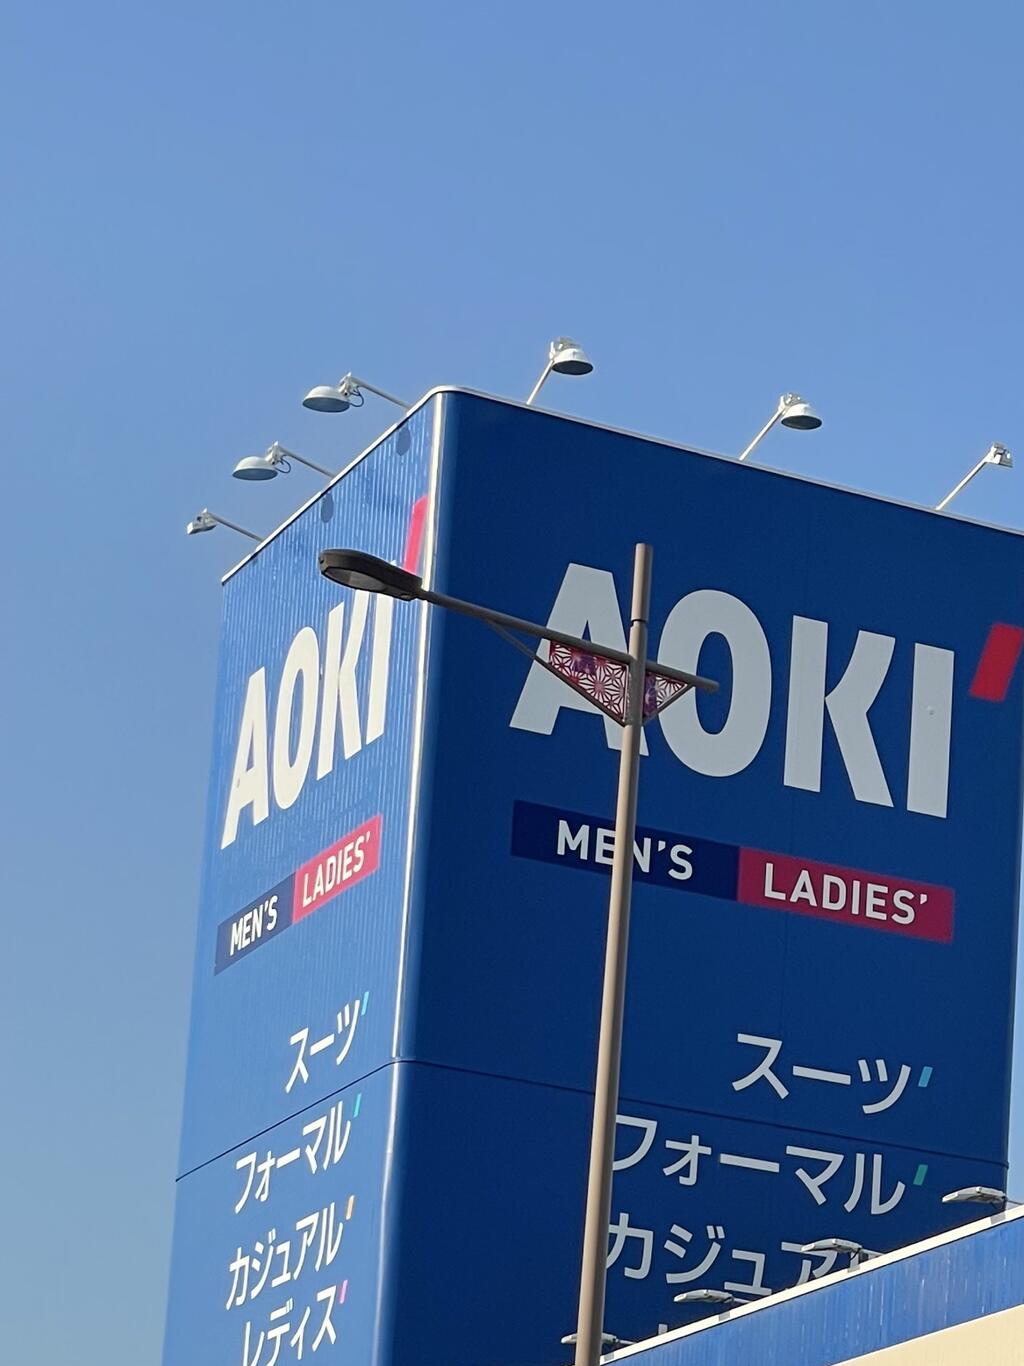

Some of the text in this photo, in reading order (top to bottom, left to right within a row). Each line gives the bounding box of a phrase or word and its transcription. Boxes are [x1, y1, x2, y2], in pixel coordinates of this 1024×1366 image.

[220, 562, 394, 849] AOKI
[510, 563, 955, 819] AOKI
[230, 831, 371, 956] MEN'S LADIES'
[764, 863, 928, 925] LADIES'
[286, 999, 360, 1093] スーツ
[732, 1033, 911, 1114] スーツ
[234, 1100, 351, 1214] フォーマル
[612, 1114, 906, 1215] フォーマル
[226, 1202, 343, 1310] カジュアル
[606, 1212, 840, 1297] カジュア
